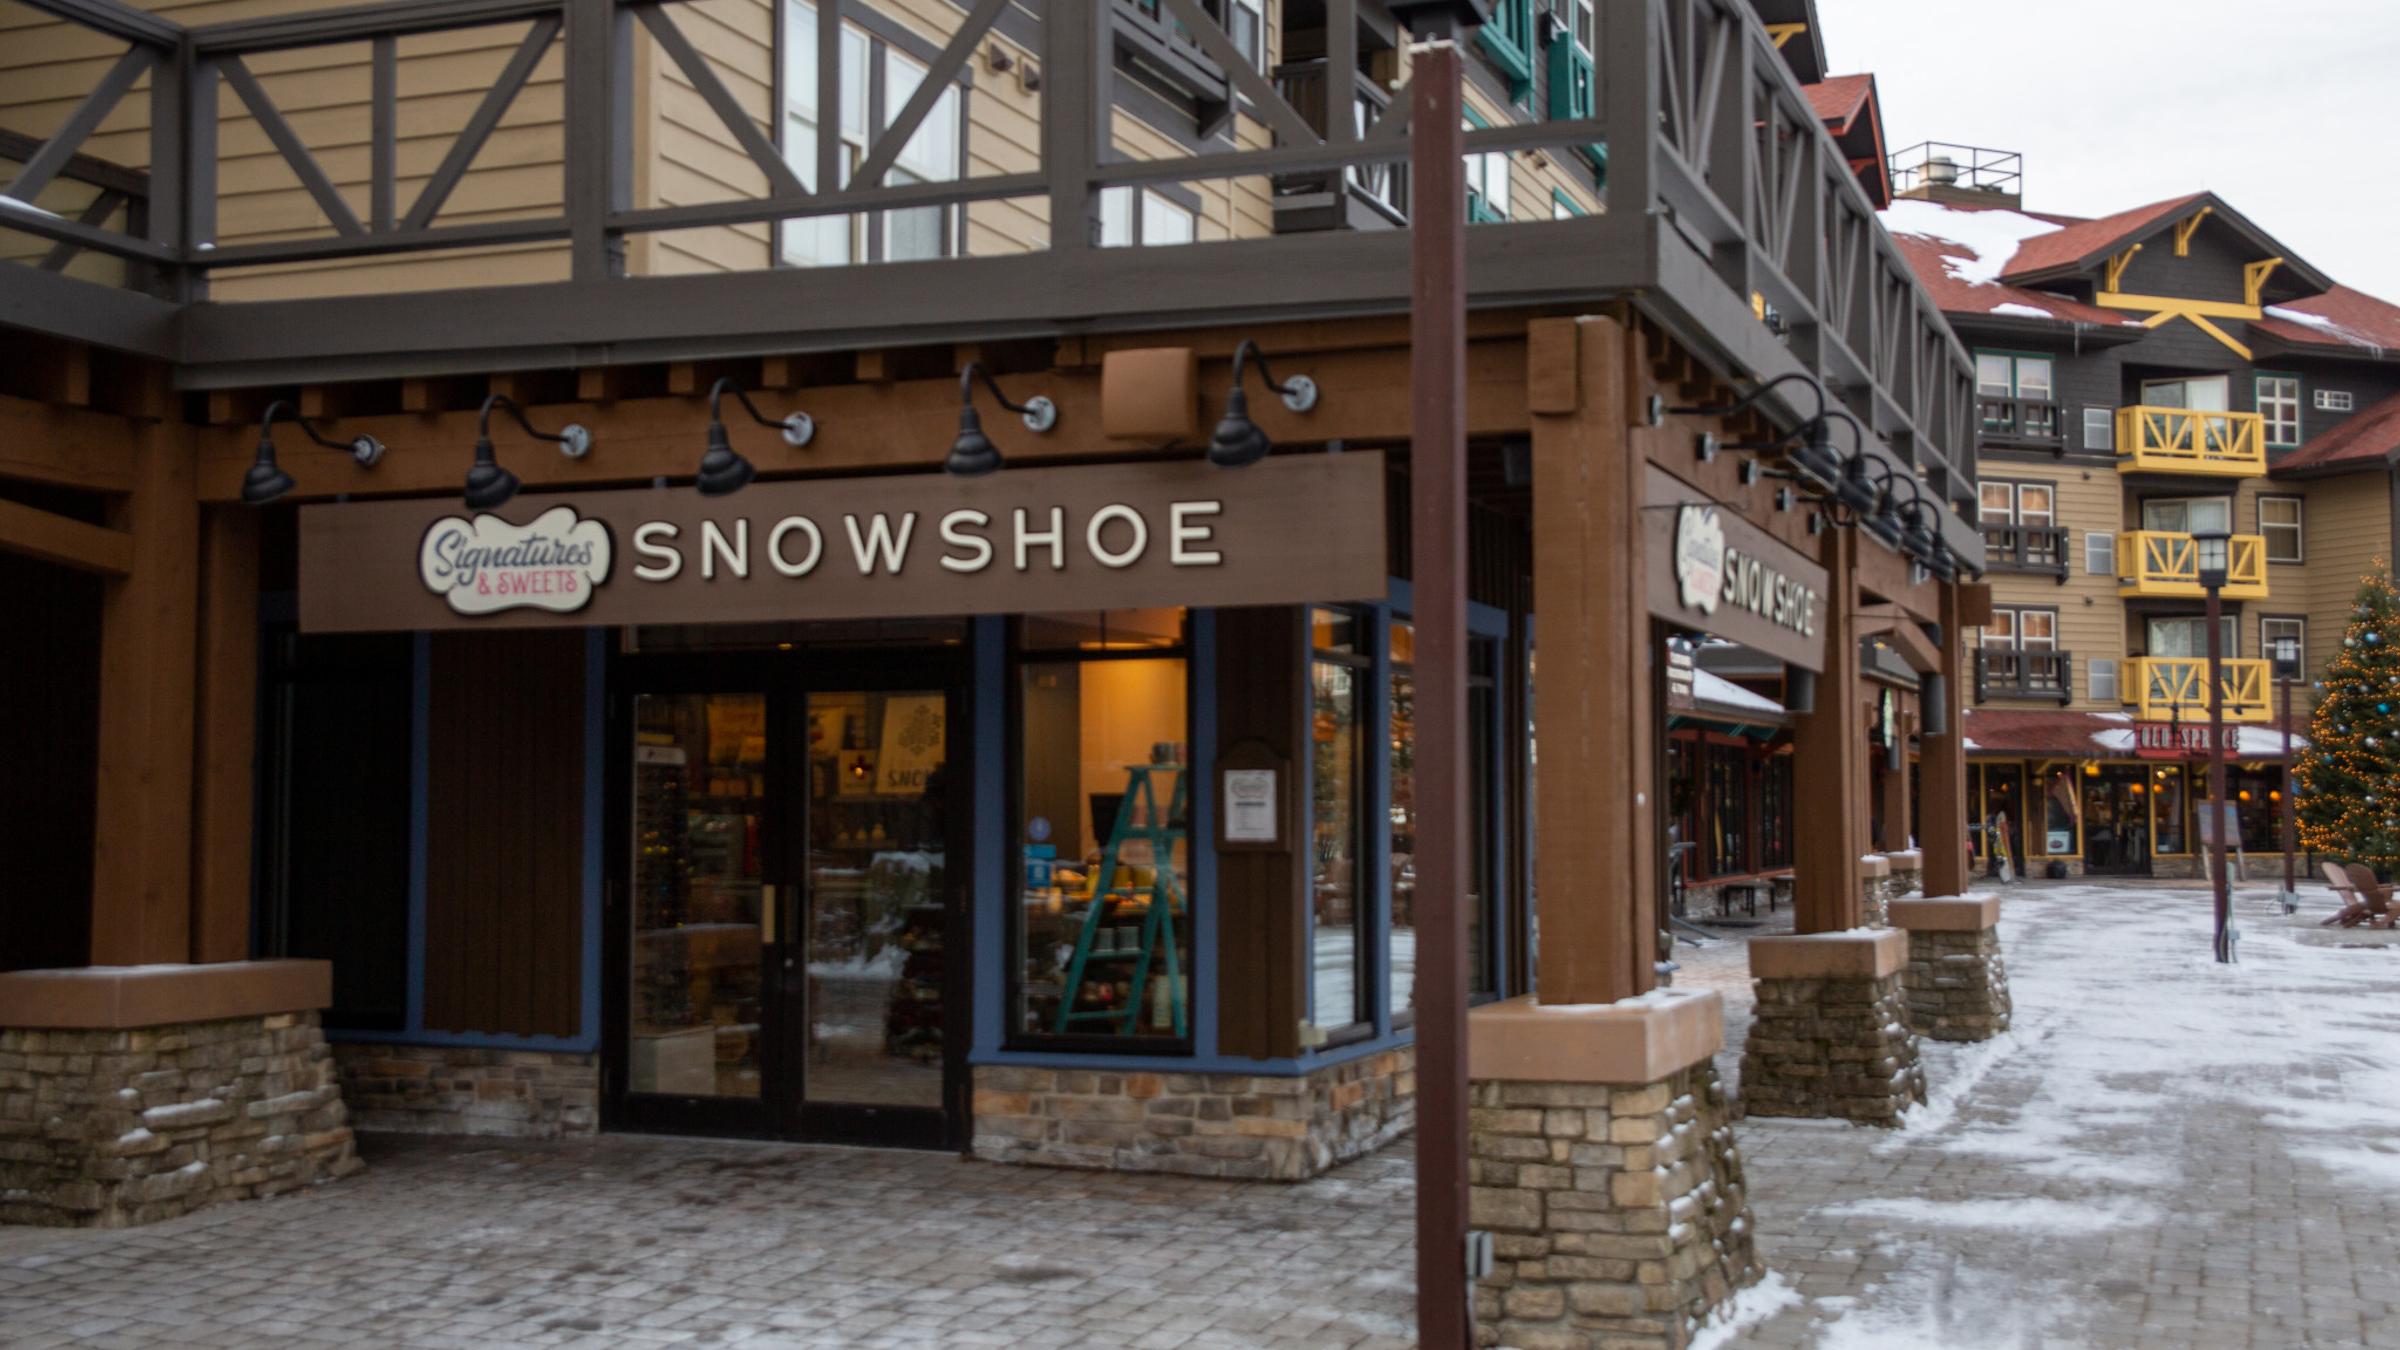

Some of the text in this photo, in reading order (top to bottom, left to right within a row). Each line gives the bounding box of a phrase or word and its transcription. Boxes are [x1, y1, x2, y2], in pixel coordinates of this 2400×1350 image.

[435, 529, 594, 586] Signatures
[633, 500, 1222, 581] SNOWSHOE
[477, 569, 578, 595] & SWEETS
[1722, 546, 1815, 638] SNOWSHOE
[2141, 726, 2239, 750] OLD SPRCE
